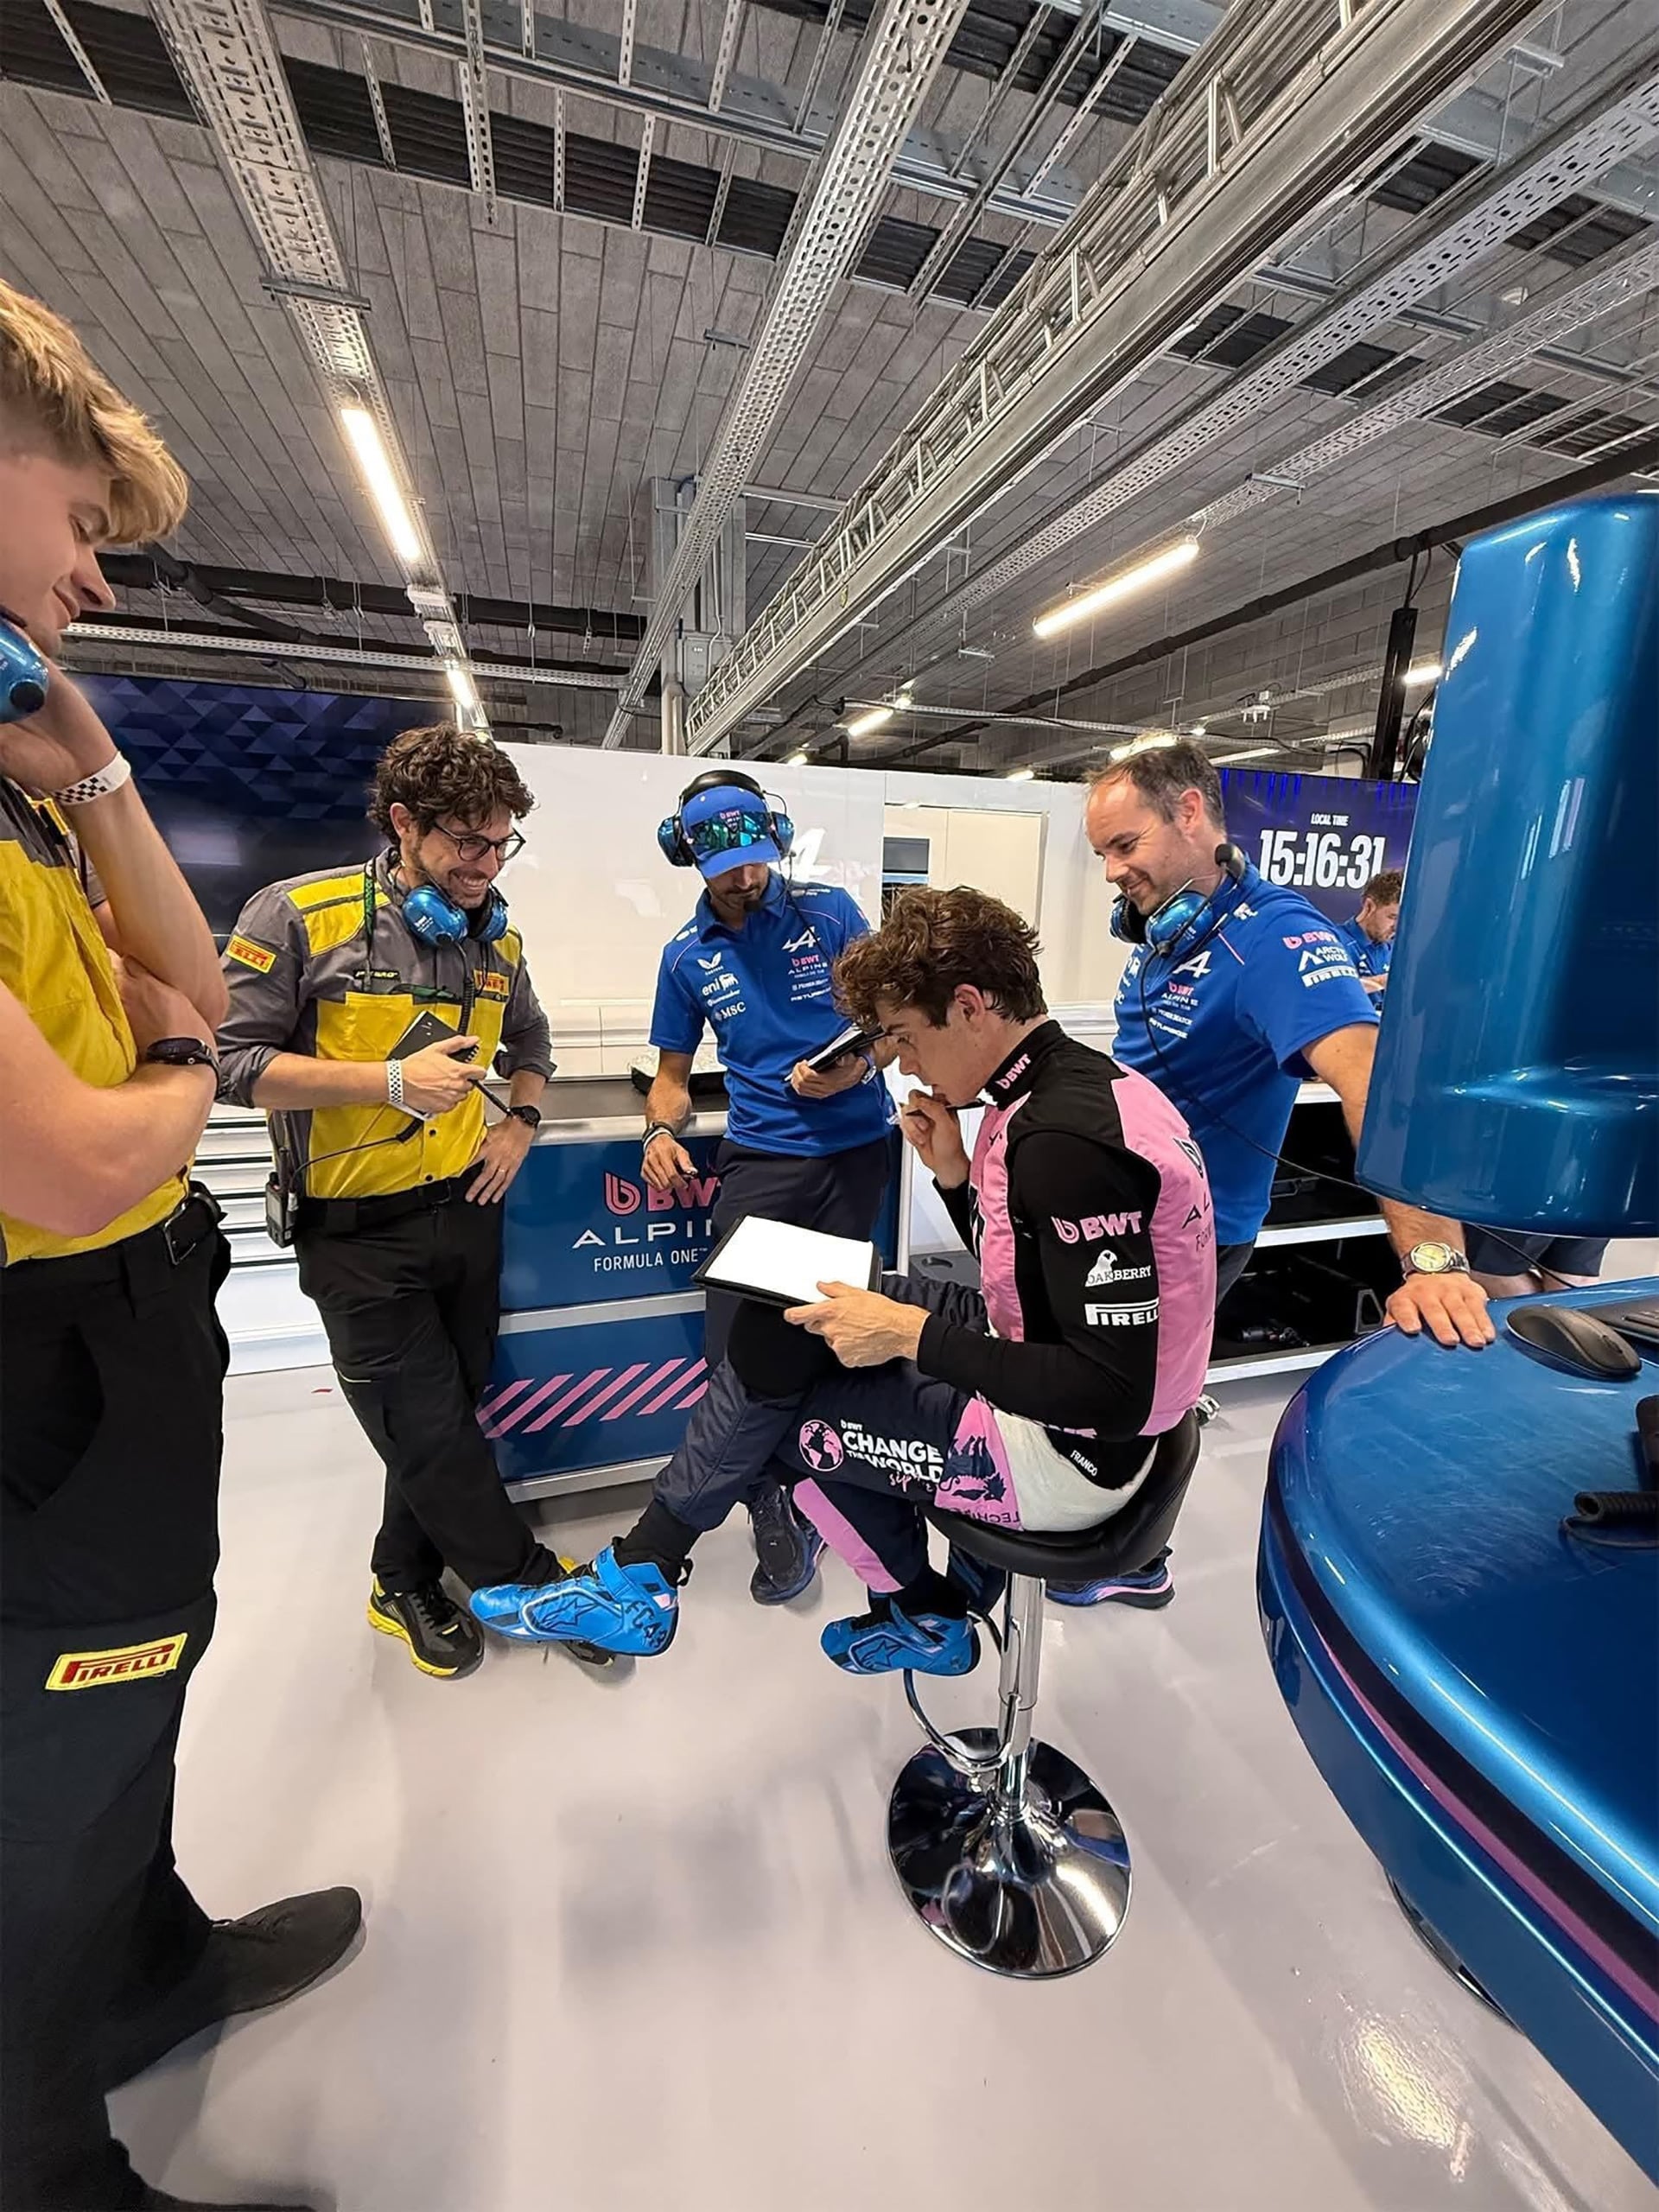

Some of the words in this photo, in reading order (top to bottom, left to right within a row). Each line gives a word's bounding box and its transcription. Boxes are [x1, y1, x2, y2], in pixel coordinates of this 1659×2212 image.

[1311, 813, 1332, 825] LOCAL
[1332, 815, 1349, 826] TIME
[1260, 830, 1386, 889] 15:16:31
[721, 1001, 747, 1019] MSC
[647, 1176, 721, 1211] BW
[572, 1219, 712, 1249] ALPI
[1079, 1211, 1142, 1241] BWT
[594, 1252, 664, 1272] FORMULA
[1086, 1265, 1152, 1285] OAKBERRY
[1084, 1297, 1160, 1325] PIRELL
[842, 1431, 944, 1464] CHANGE
[864, 1454, 944, 1483] WORLD
[1070, 1450, 1098, 1477] FRANCO
[60, 1643, 175, 1684] PIRELLI
